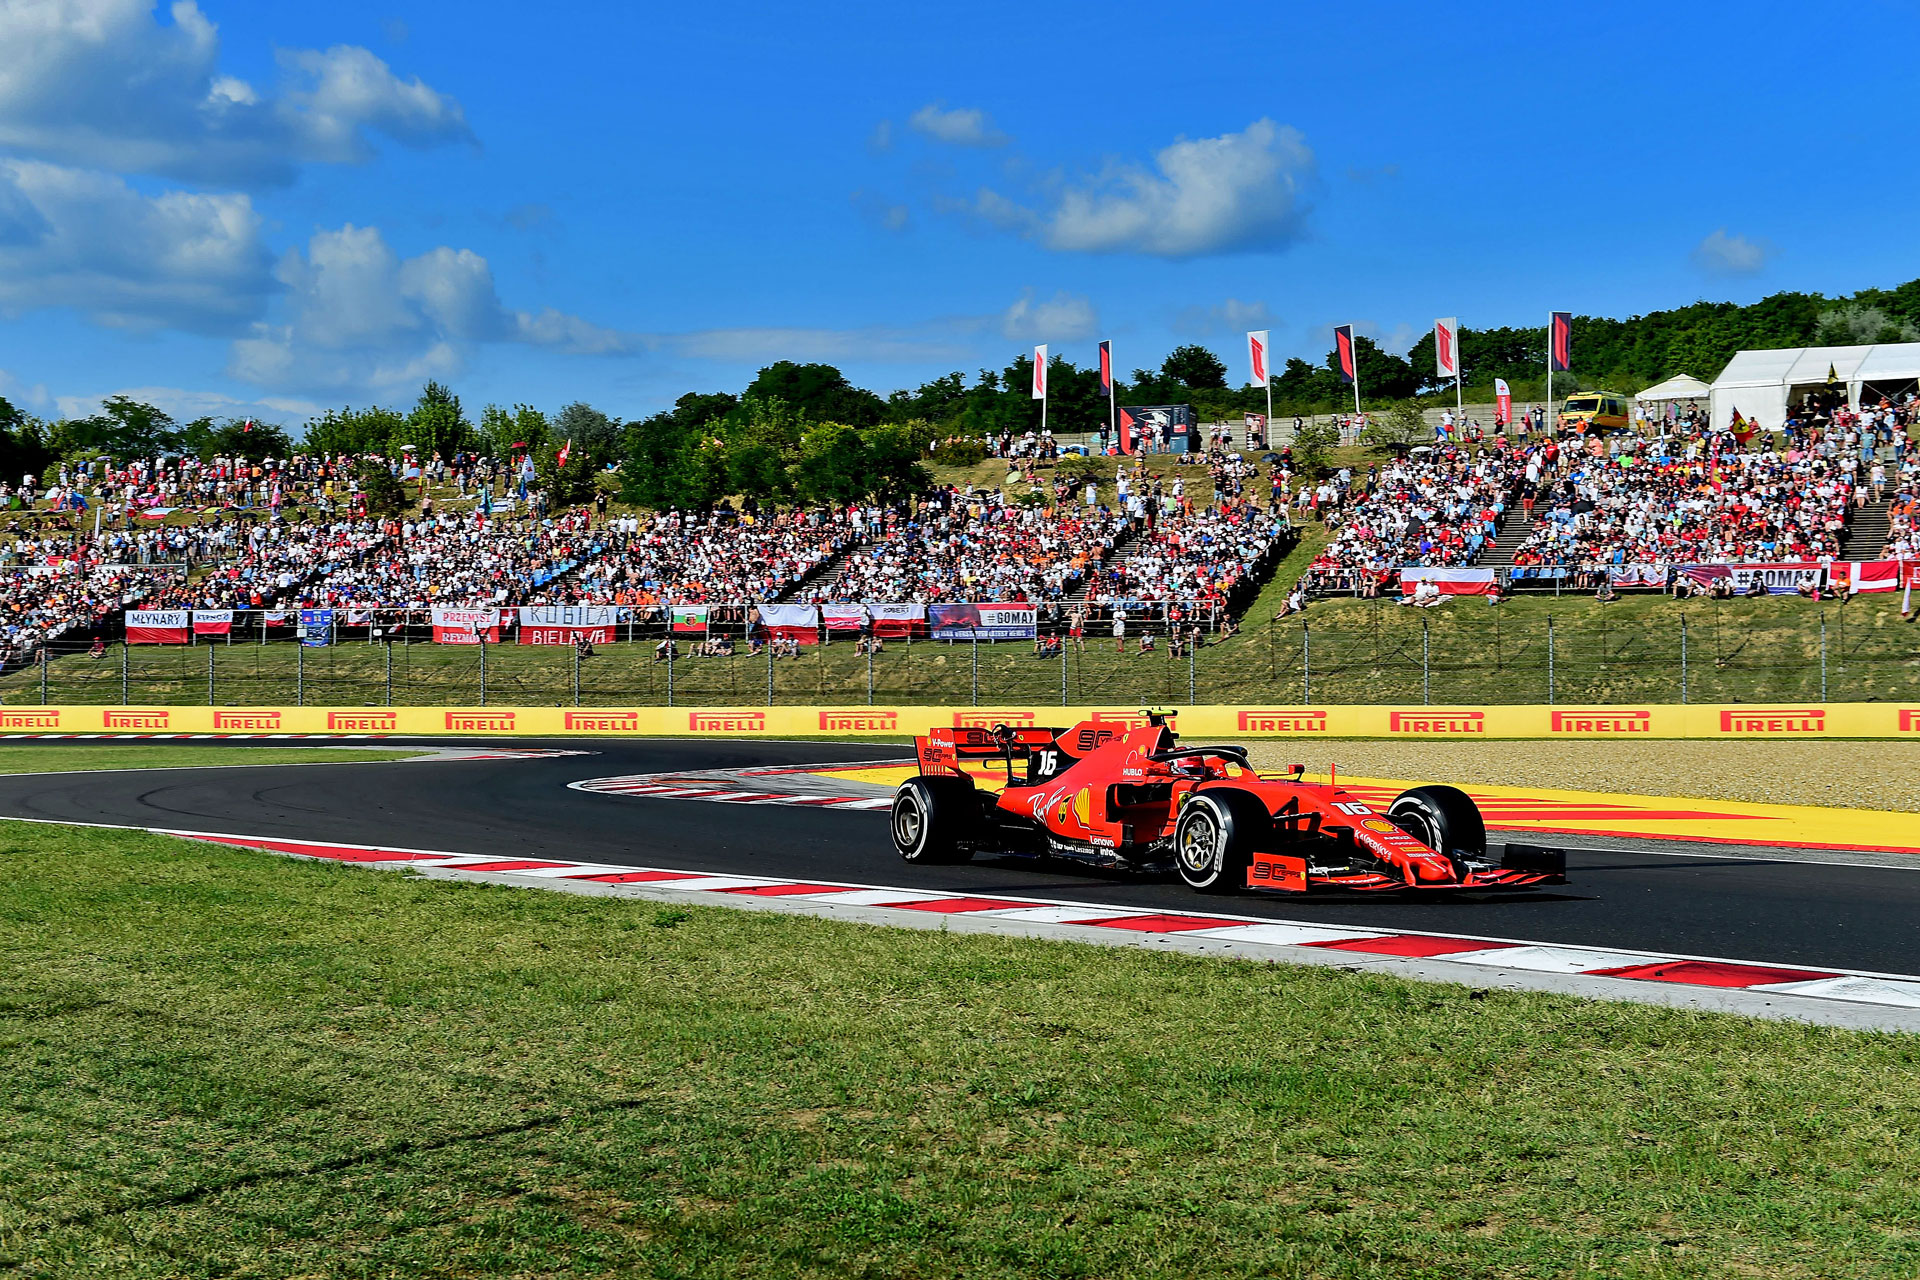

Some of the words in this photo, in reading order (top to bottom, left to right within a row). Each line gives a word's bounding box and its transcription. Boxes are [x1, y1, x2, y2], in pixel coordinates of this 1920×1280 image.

[531, 606, 610, 625] KUBICA
[103, 711, 169, 728] PIRELLI
[213, 711, 280, 728] PIRELLI
[328, 712, 396, 729] PIRELLI
[446, 712, 515, 730] PIRELLI
[565, 712, 637, 730] PIRELLI
[690, 712, 764, 730] PIRELLI
[819, 711, 897, 730] PIRELLI
[1238, 711, 1326, 731] PIRELLI
[1391, 711, 1484, 732] PIRELLI
[1552, 711, 1650, 731] PIRELLI
[1720, 710, 1825, 731] PIRELLI
[932, 738, 953, 748] V-Power
[1038, 751, 1057, 775] 16
[1330, 802, 1373, 816] 16
[1090, 835, 1115, 847] Lenovo
